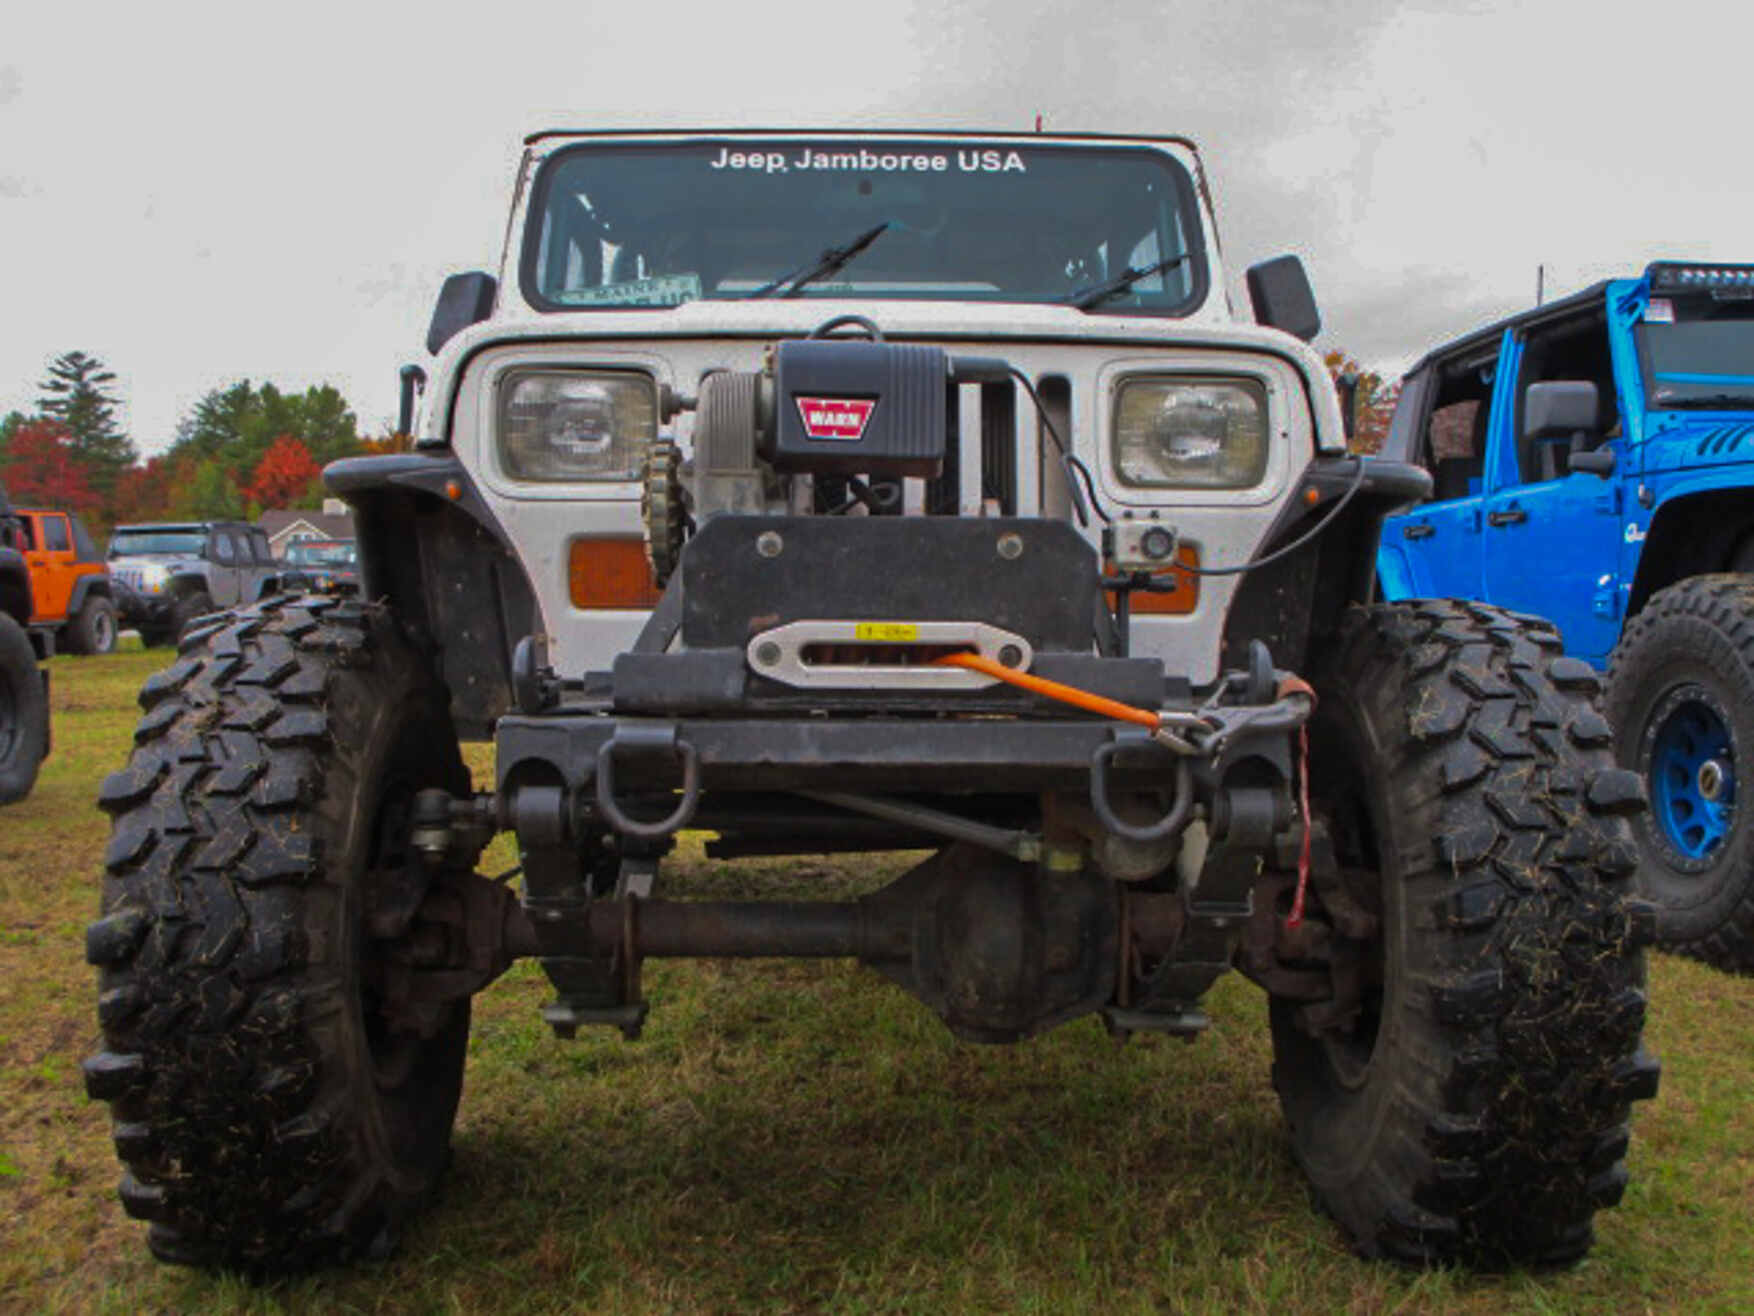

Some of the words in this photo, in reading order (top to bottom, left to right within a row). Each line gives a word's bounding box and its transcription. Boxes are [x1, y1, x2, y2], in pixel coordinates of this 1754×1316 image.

[711, 148, 785, 173] Jeep
[794, 148, 947, 172] Jamboree
[958, 150, 1026, 173] USA
[810, 410, 862, 426] WARN
